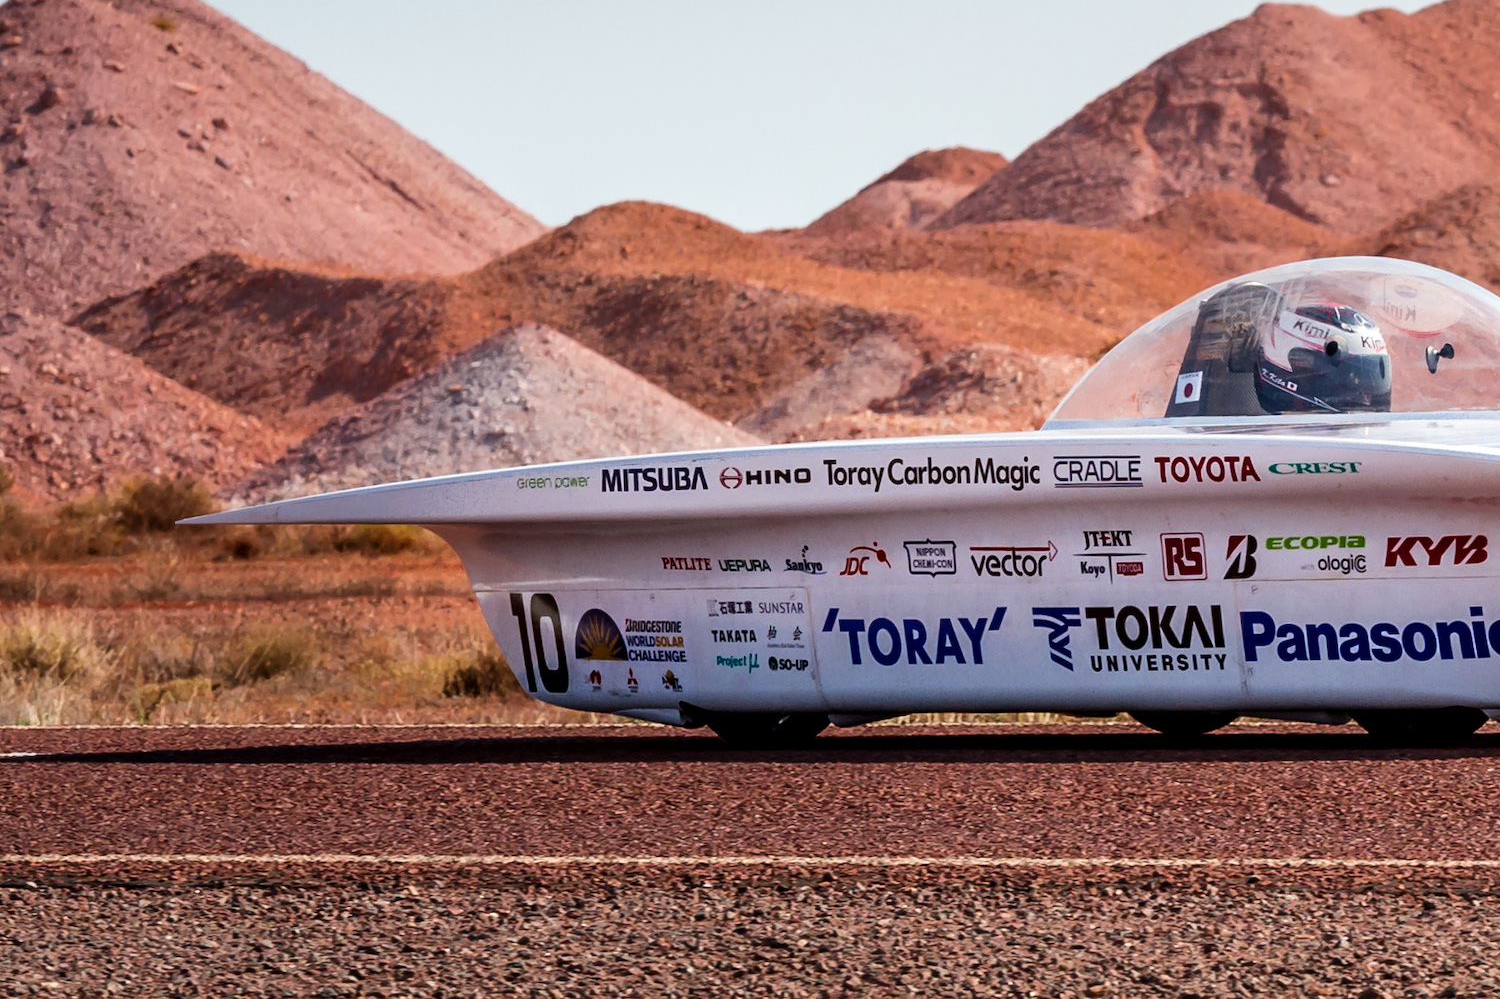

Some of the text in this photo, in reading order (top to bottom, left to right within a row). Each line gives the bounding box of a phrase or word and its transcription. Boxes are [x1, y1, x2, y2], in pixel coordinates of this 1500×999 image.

[1293, 319, 1330, 340] Kimi
[745, 467, 811, 485] HINO
[823, 456, 1040, 492] Toray Carbon Magic
[1053, 459, 1143, 482] CRADLE
[1154, 456, 1261, 483] TOYOTA
[1268, 461, 1363, 475] CREST
[601, 467, 709, 492] MITSUBA
[1082, 530, 1133, 550] JTEKT
[915, 547, 946, 558] NIPPON
[1164, 537, 1204, 576] RS
[1384, 534, 1489, 567] KYB
[661, 557, 712, 572] PATLITE
[718, 559, 772, 572] UEPURA
[785, 558, 823, 574] Sankyo
[839, 556, 870, 576] JDC
[912, 559, 953, 570] CHEMI-CON
[971, 548, 1048, 577] vector
[1080, 561, 1106, 578] Koyo
[758, 602, 805, 614] SUNSTAR
[625, 618, 682, 633] BRIDGESTONE
[1085, 604, 1227, 651] TOKAI
[509, 593, 570, 693] 10
[711, 629, 757, 642] TAKATA
[628, 650, 687, 662] CHALLENGE
[716, 655, 747, 669] Project
[779, 658, 809, 671] SO-UP
[1090, 653, 1227, 672] UNIVERSITY
